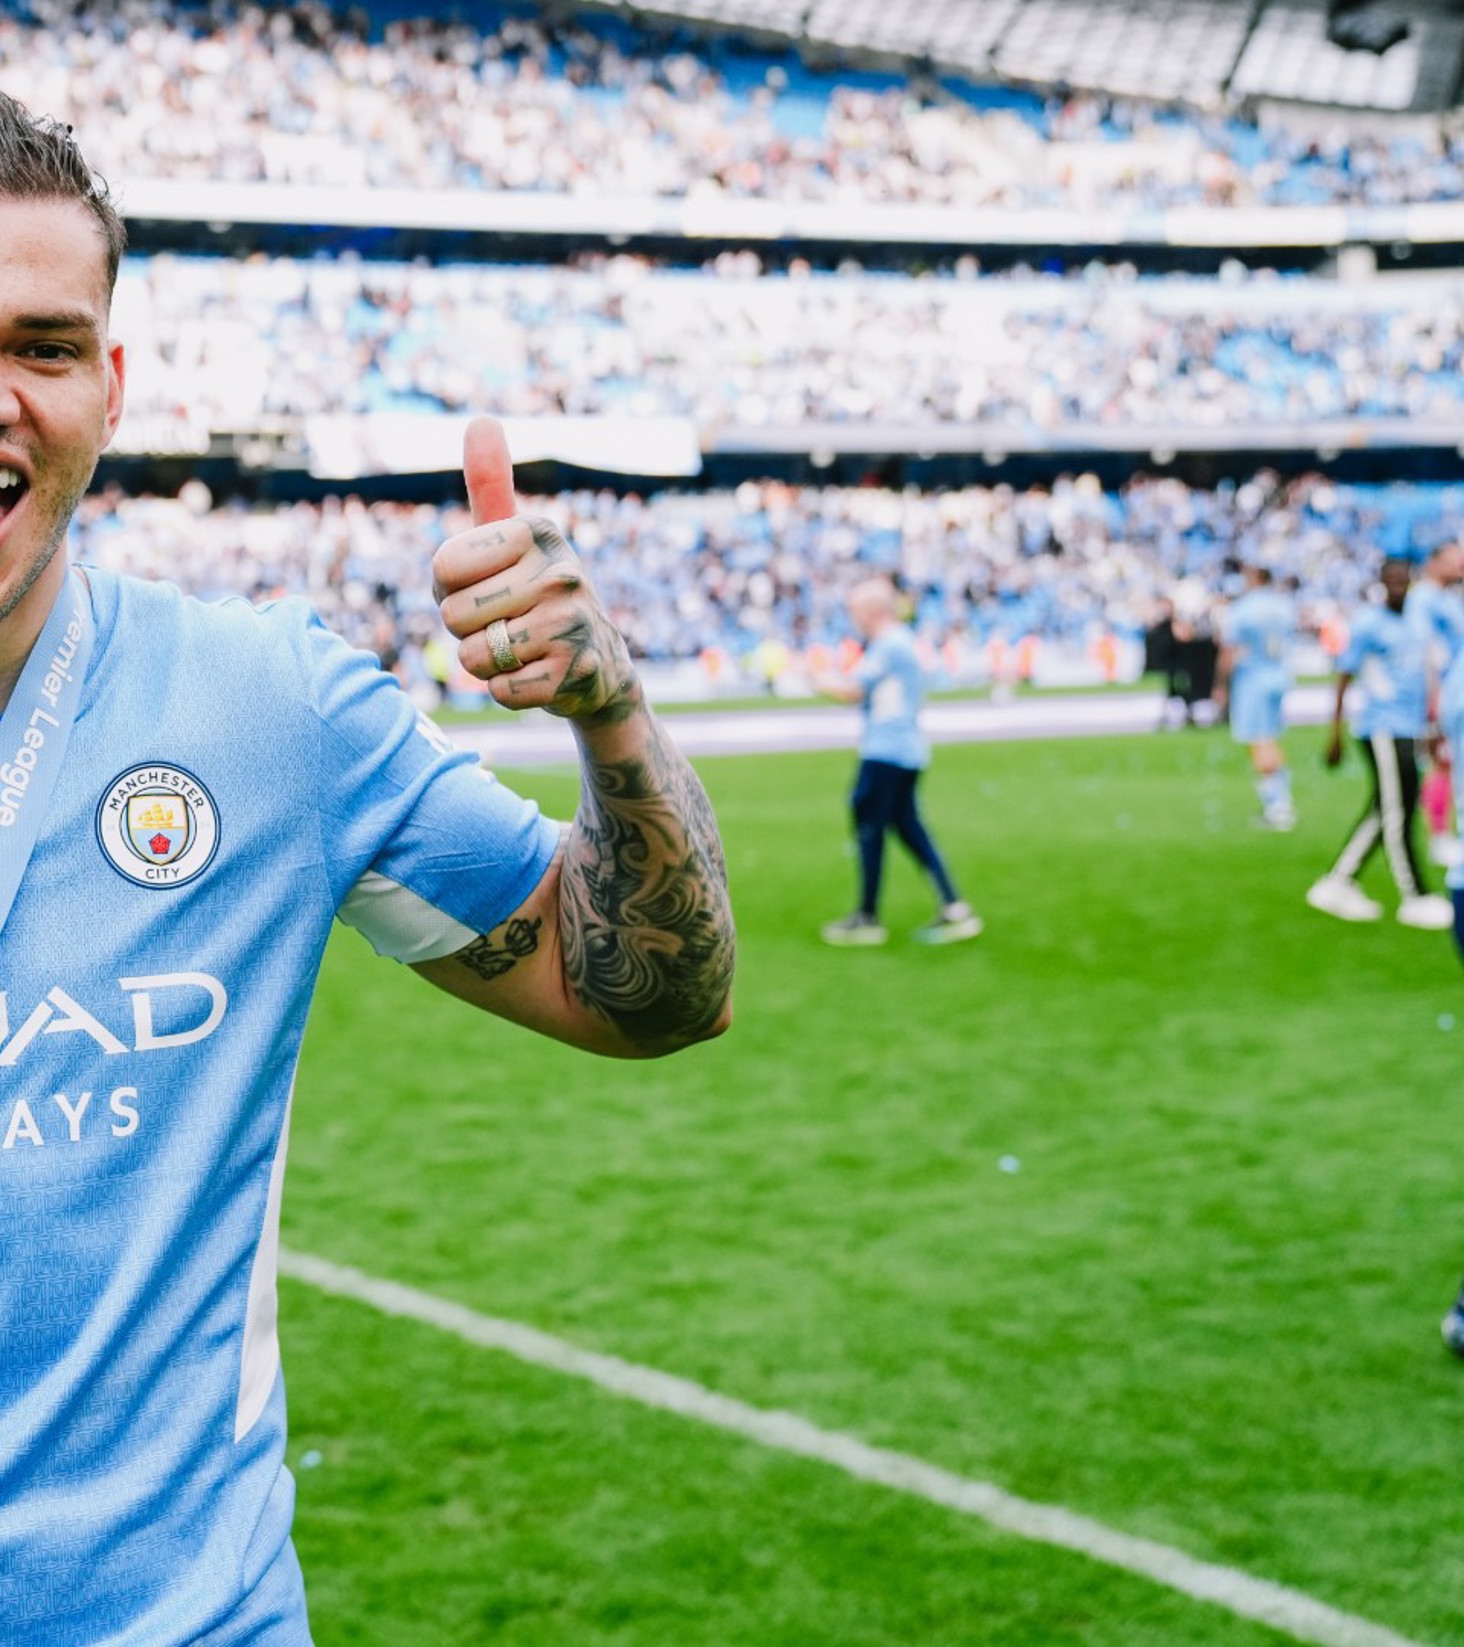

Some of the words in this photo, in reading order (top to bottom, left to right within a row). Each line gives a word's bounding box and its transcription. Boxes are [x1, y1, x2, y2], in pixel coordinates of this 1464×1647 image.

[40, 605, 88, 708] remier
[108, 771, 205, 811] MANCHESTER
[145, 867, 181, 880] CITY
